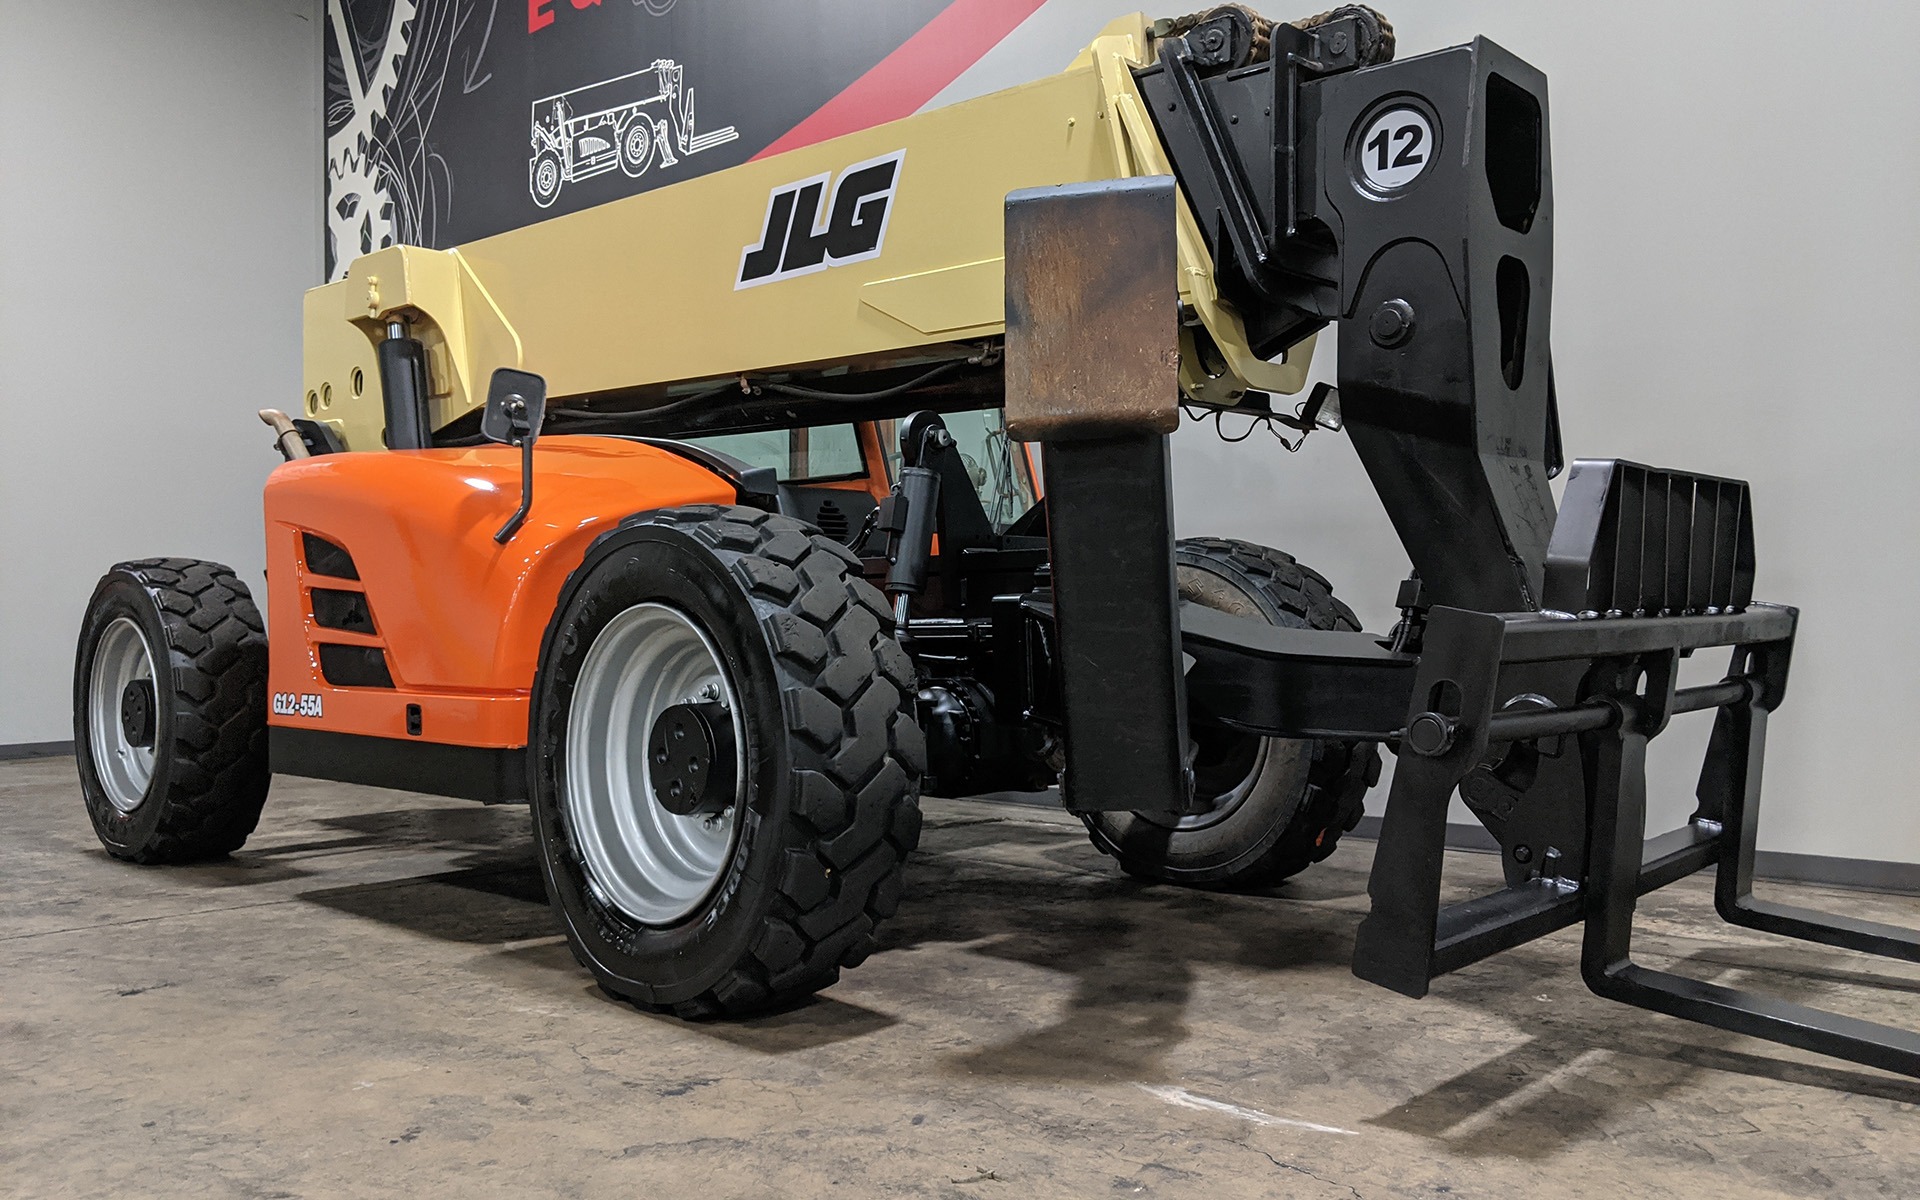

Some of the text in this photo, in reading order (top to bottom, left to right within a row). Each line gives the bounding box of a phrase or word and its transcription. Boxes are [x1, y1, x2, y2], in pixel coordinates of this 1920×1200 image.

[1368, 124, 1423, 171] 12
[740, 157, 899, 283] JLG
[273, 692, 323, 717] G12-55A
